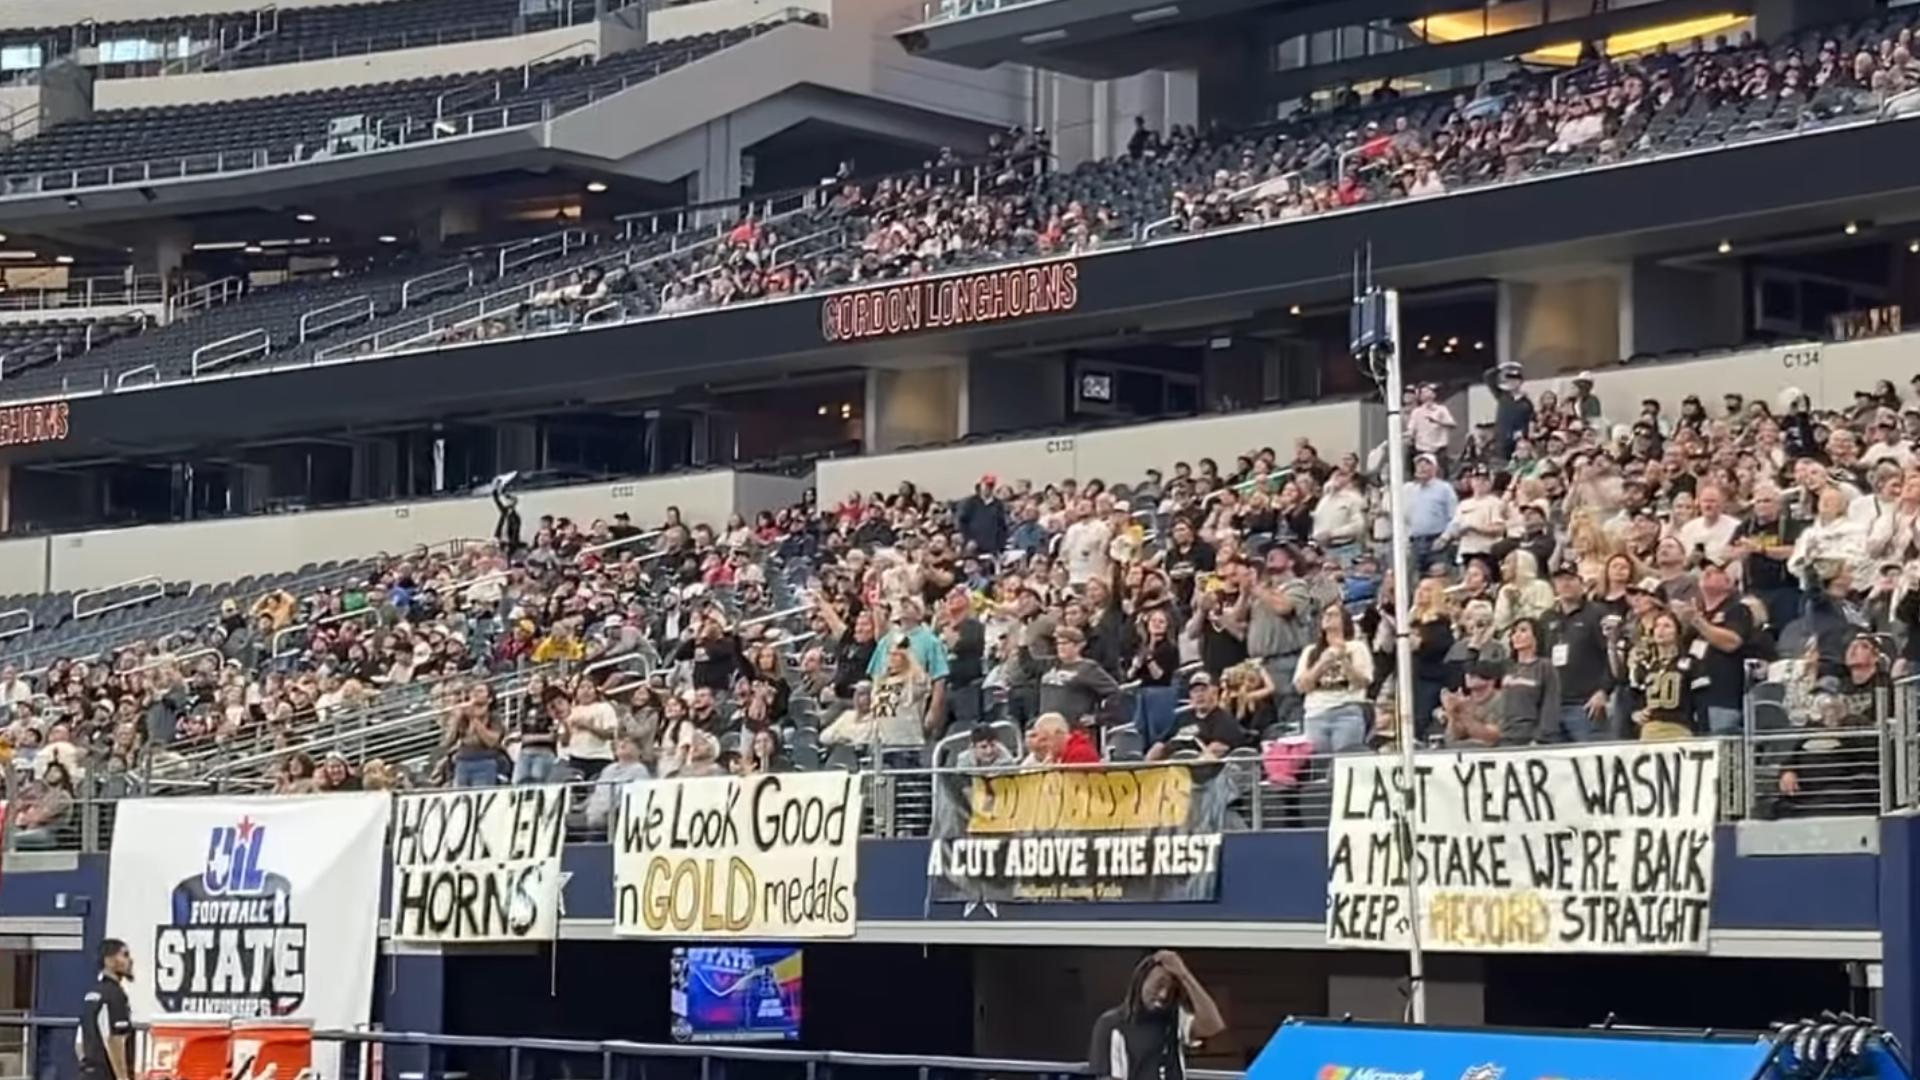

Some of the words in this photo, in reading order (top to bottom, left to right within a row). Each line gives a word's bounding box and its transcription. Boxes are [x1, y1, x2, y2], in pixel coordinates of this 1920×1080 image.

[822, 285, 920, 341] GORDON
[925, 262, 1078, 327] LONGHORNS
[1783, 352, 1819, 368] C134
[1645, 672, 1682, 709] 20
[624, 790, 664, 853] We
[752, 775, 852, 852] Good
[1453, 758, 1555, 822] YEAR
[1570, 748, 1714, 817] WASN'T
[395, 792, 497, 865] HOOK
[927, 840, 946, 876] A
[949, 840, 1000, 876] CUT
[1005, 836, 1088, 877] ABOVE
[1094, 836, 1147, 876] THE
[1152, 833, 1223, 876] REST
[1329, 833, 1354, 884] A
[1521, 827, 1622, 892] WE'RE
[1632, 828, 1709, 893] BACK
[190, 899, 270, 924] FOOTBALL
[643, 856, 757, 931] GOLD
[763, 856, 850, 924] medals
[1330, 893, 1399, 941] KEEP
[1429, 893, 1548, 945] RECORD
[1559, 896, 1708, 943] STRAIGHT
[157, 928, 304, 993] STATE
